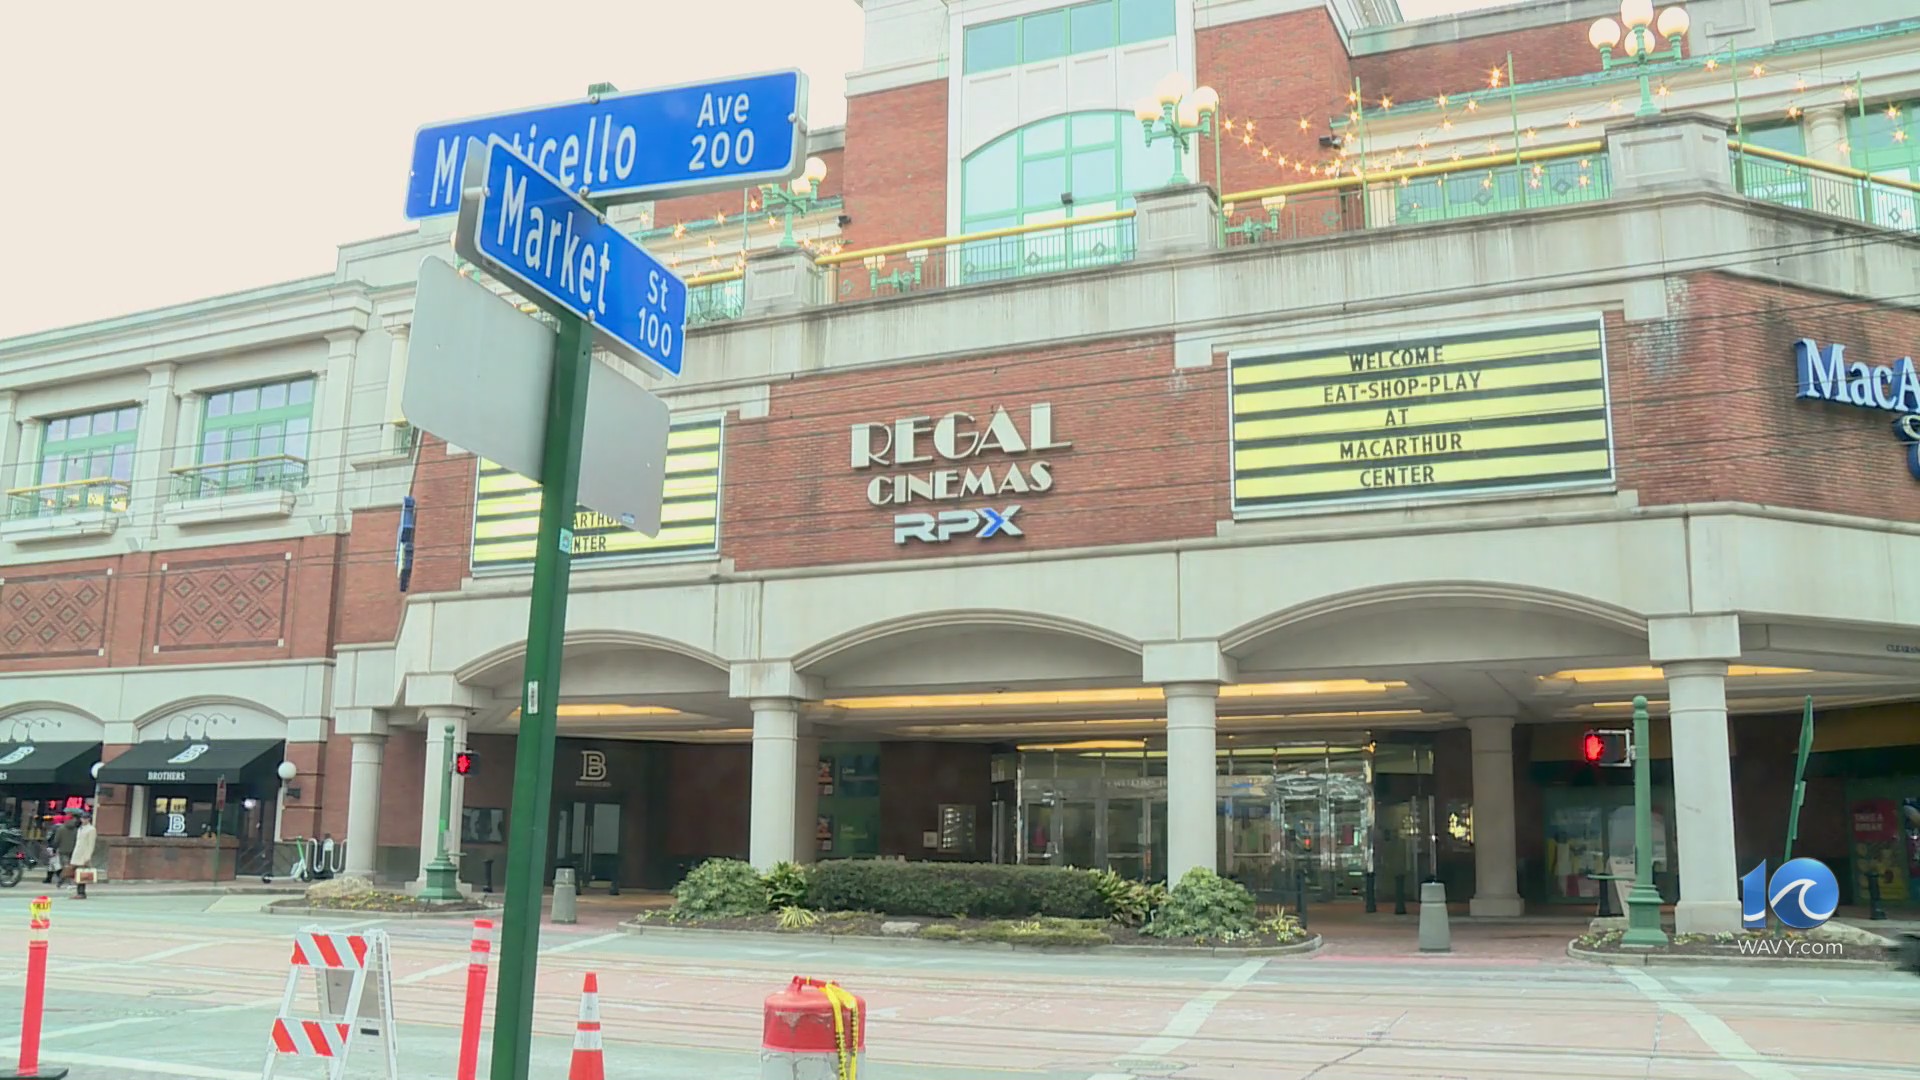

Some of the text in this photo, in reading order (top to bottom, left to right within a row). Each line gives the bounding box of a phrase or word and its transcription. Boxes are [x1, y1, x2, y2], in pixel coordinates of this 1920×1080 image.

[430, 92, 750, 208] Micello Ave
[688, 127, 755, 172] 200
[497, 164, 669, 316] Market St
[638, 306, 673, 358] 100
[1349, 345, 1445, 373] WELCOME
[1323, 371, 1482, 404] EAT-SHOP-PLAY
[1384, 408, 1409, 427] AT
[851, 402, 1073, 469] REGAL
[1339, 433, 1463, 460] MACARTHUR
[866, 460, 1053, 506] CINEMAS
[1359, 465, 1435, 488] CENTER
[894, 504, 1024, 544] RPX
[573, 536, 607, 552] NTER
[147, 771, 186, 781] BROTHERS
[579, 750, 607, 780] B
